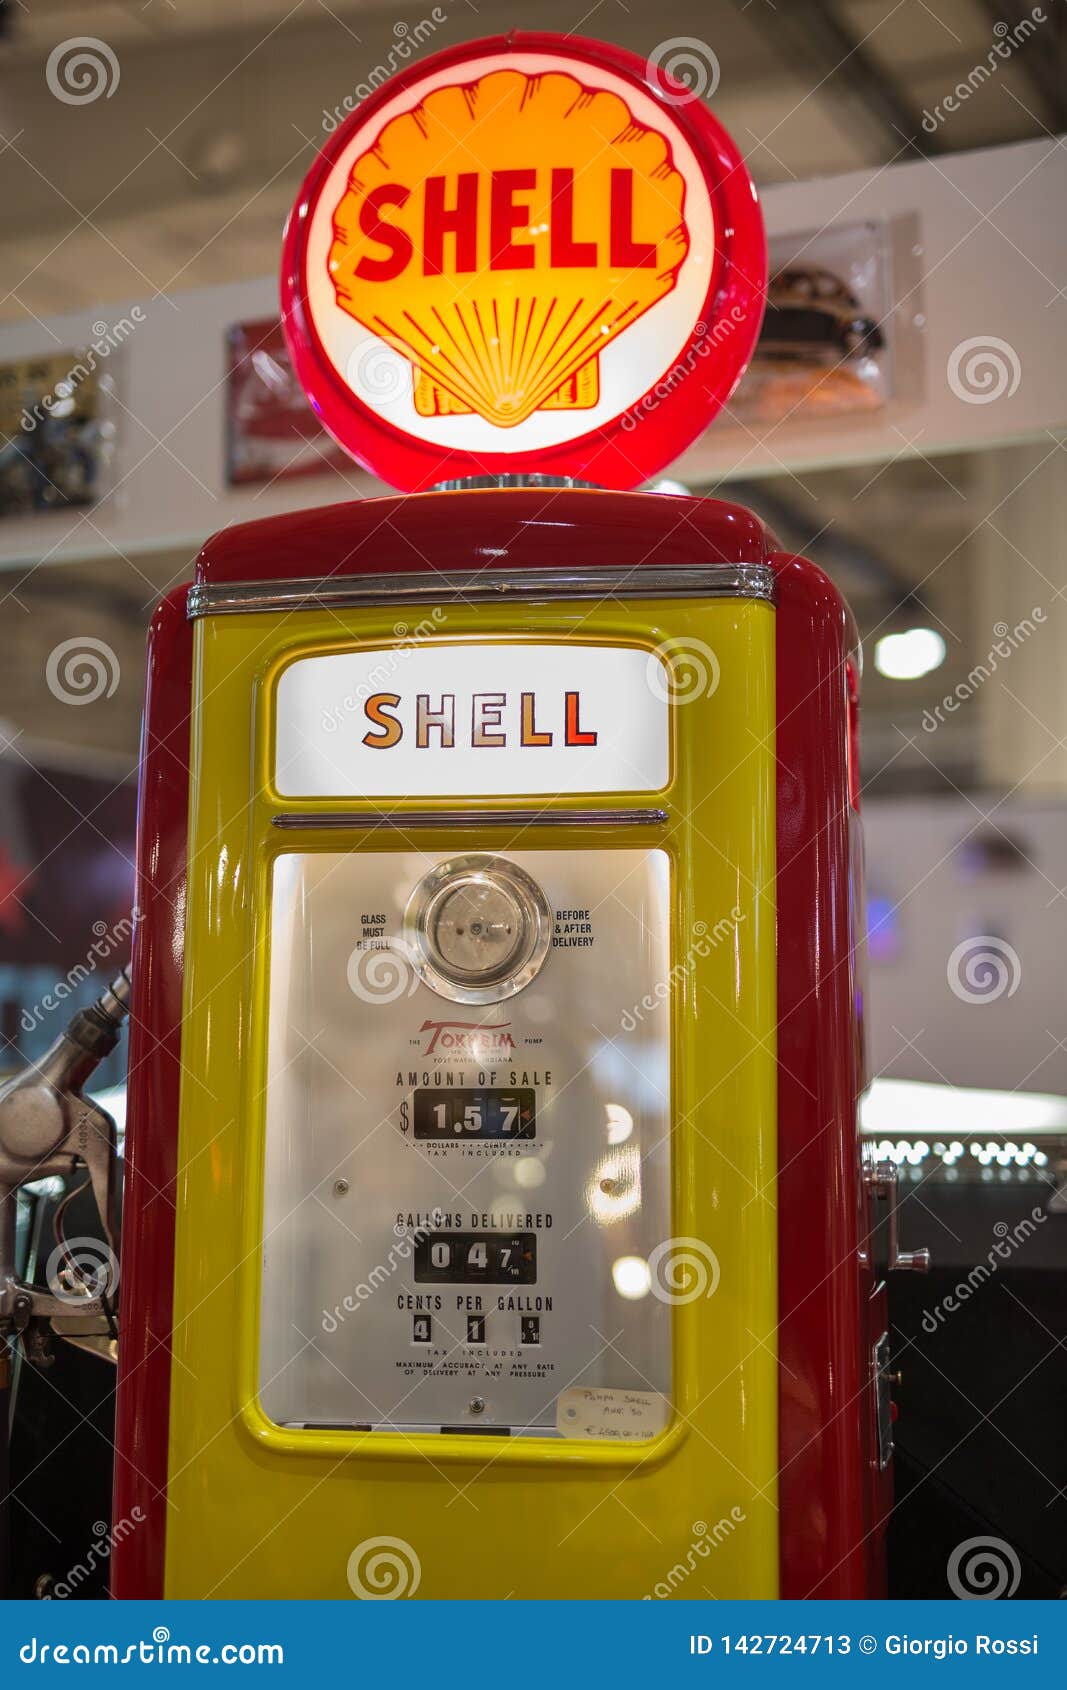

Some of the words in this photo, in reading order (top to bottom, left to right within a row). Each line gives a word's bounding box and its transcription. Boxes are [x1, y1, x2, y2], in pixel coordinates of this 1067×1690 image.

[353, 168, 657, 282] SHELL
[361, 691, 598, 750] SHELL
[361, 914, 386, 924] GLASS
[556, 910, 590, 921] BEFORE
[363, 927, 384, 937] MUST
[555, 924, 561, 934] &
[563, 923, 592, 934] AFTER
[357, 940, 368, 950] BE
[371, 940, 391, 950] FULL
[552, 936, 594, 948] DELIVERY
[396, 1071, 465, 1086] AMOUNT
[478, 1071, 497, 1086] OF
[510, 1071, 552, 1086] SALE
[400, 1097, 409, 1135] $
[396, 1213, 462, 1228] GALLONS
[471, 1213, 553, 1228] DELIVERED
[397, 1295, 442, 1310] CENTS
[456, 1296, 482, 1310] PER
[498, 1296, 553, 1311] GALLON
[462, 1349, 523, 1357] INCLUDED
